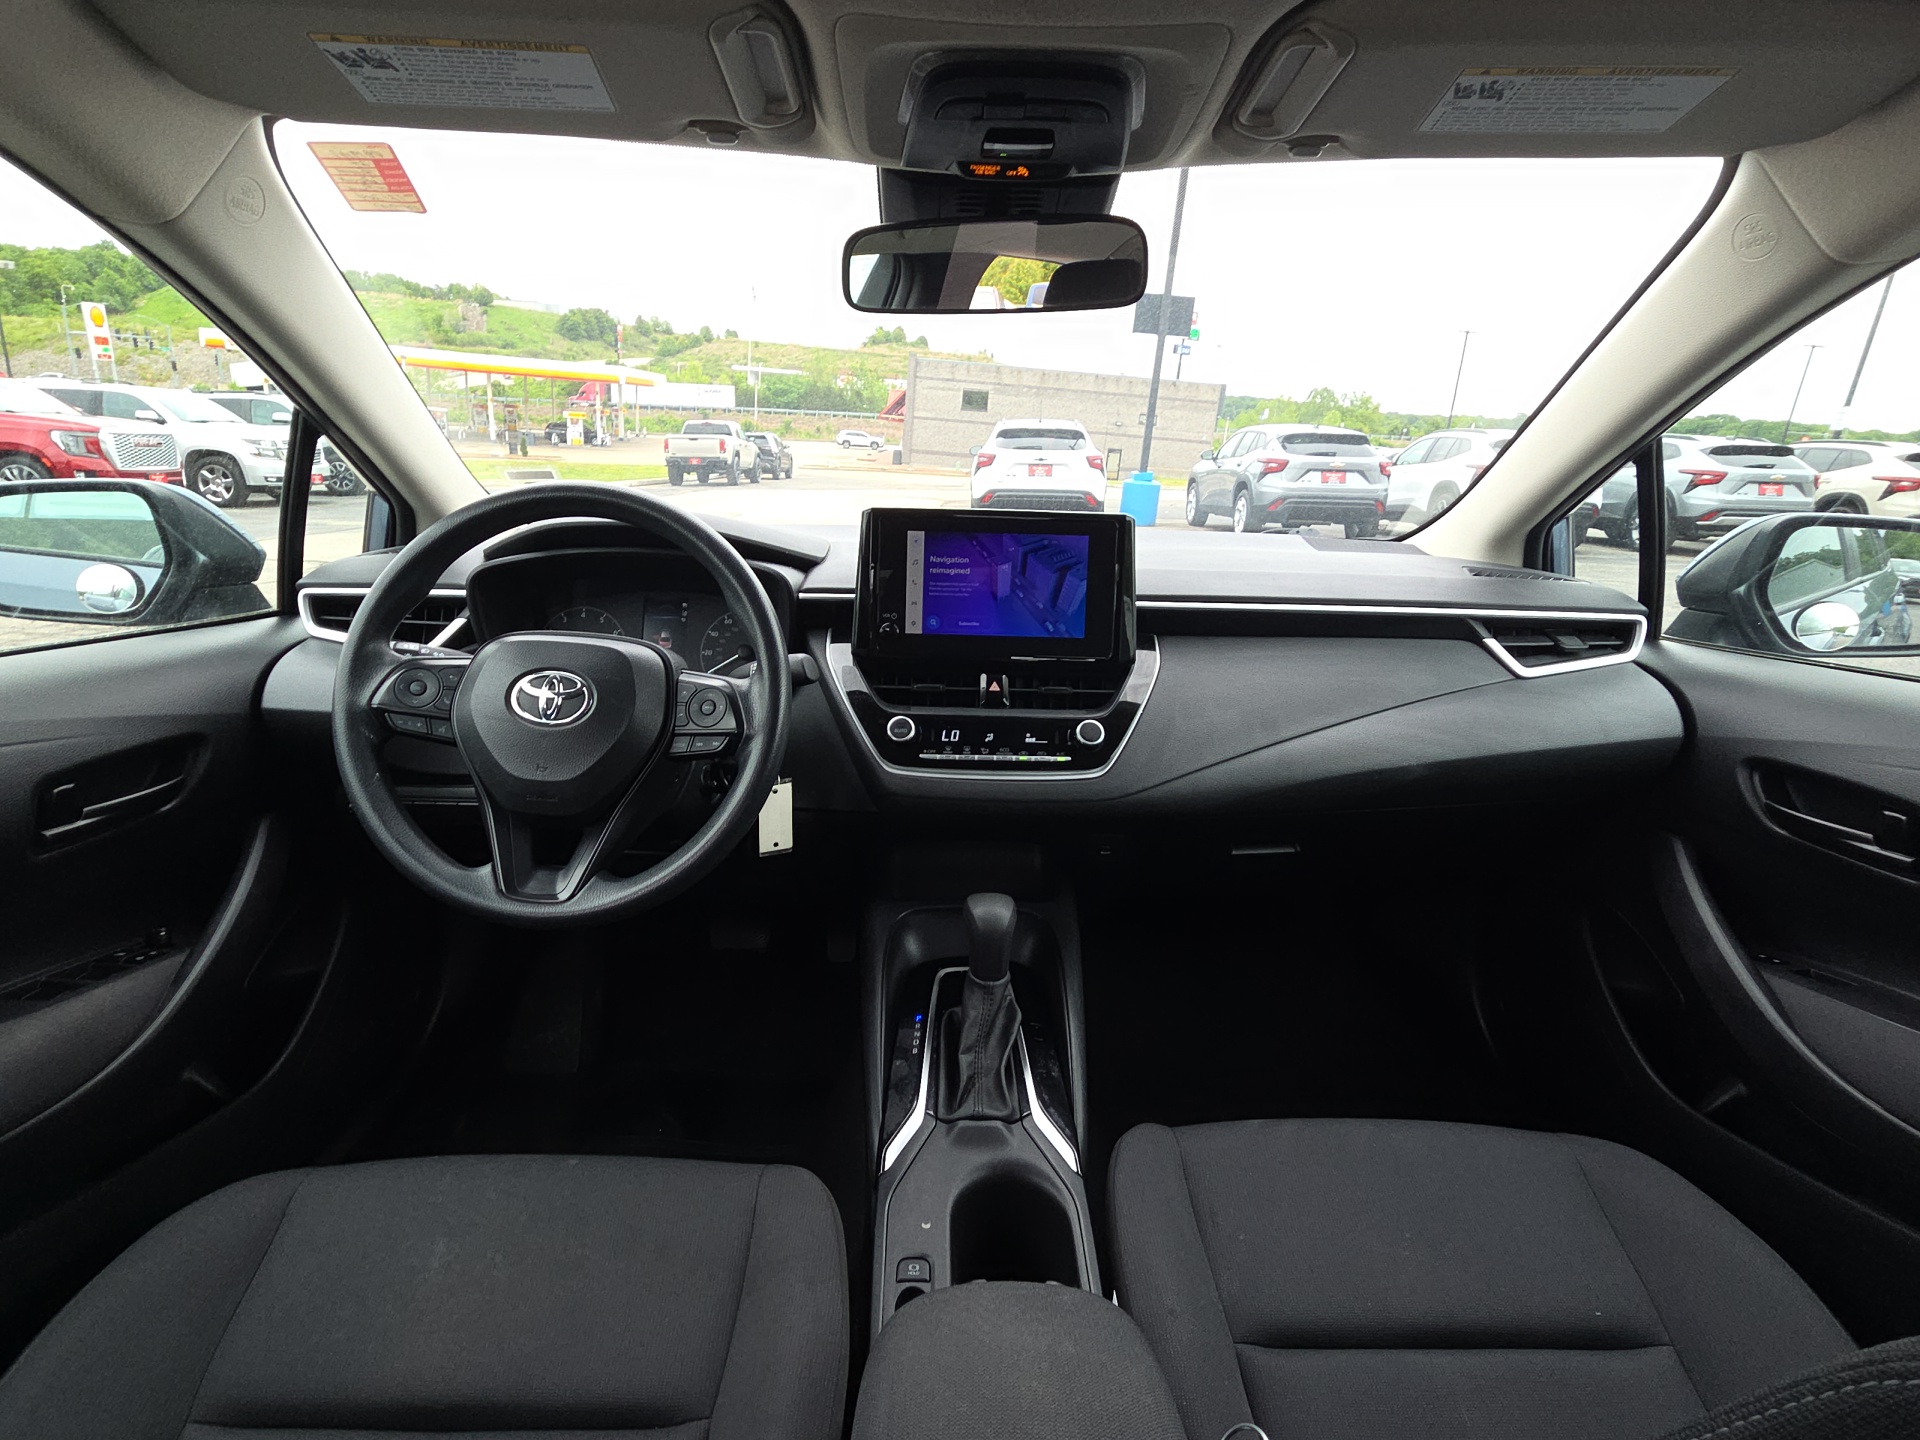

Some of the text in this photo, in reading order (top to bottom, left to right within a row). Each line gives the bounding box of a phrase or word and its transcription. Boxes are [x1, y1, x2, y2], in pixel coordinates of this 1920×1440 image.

[929, 555, 970, 565] Navigation
[929, 567, 971, 576] reimagined
[941, 729, 960, 742] LO
